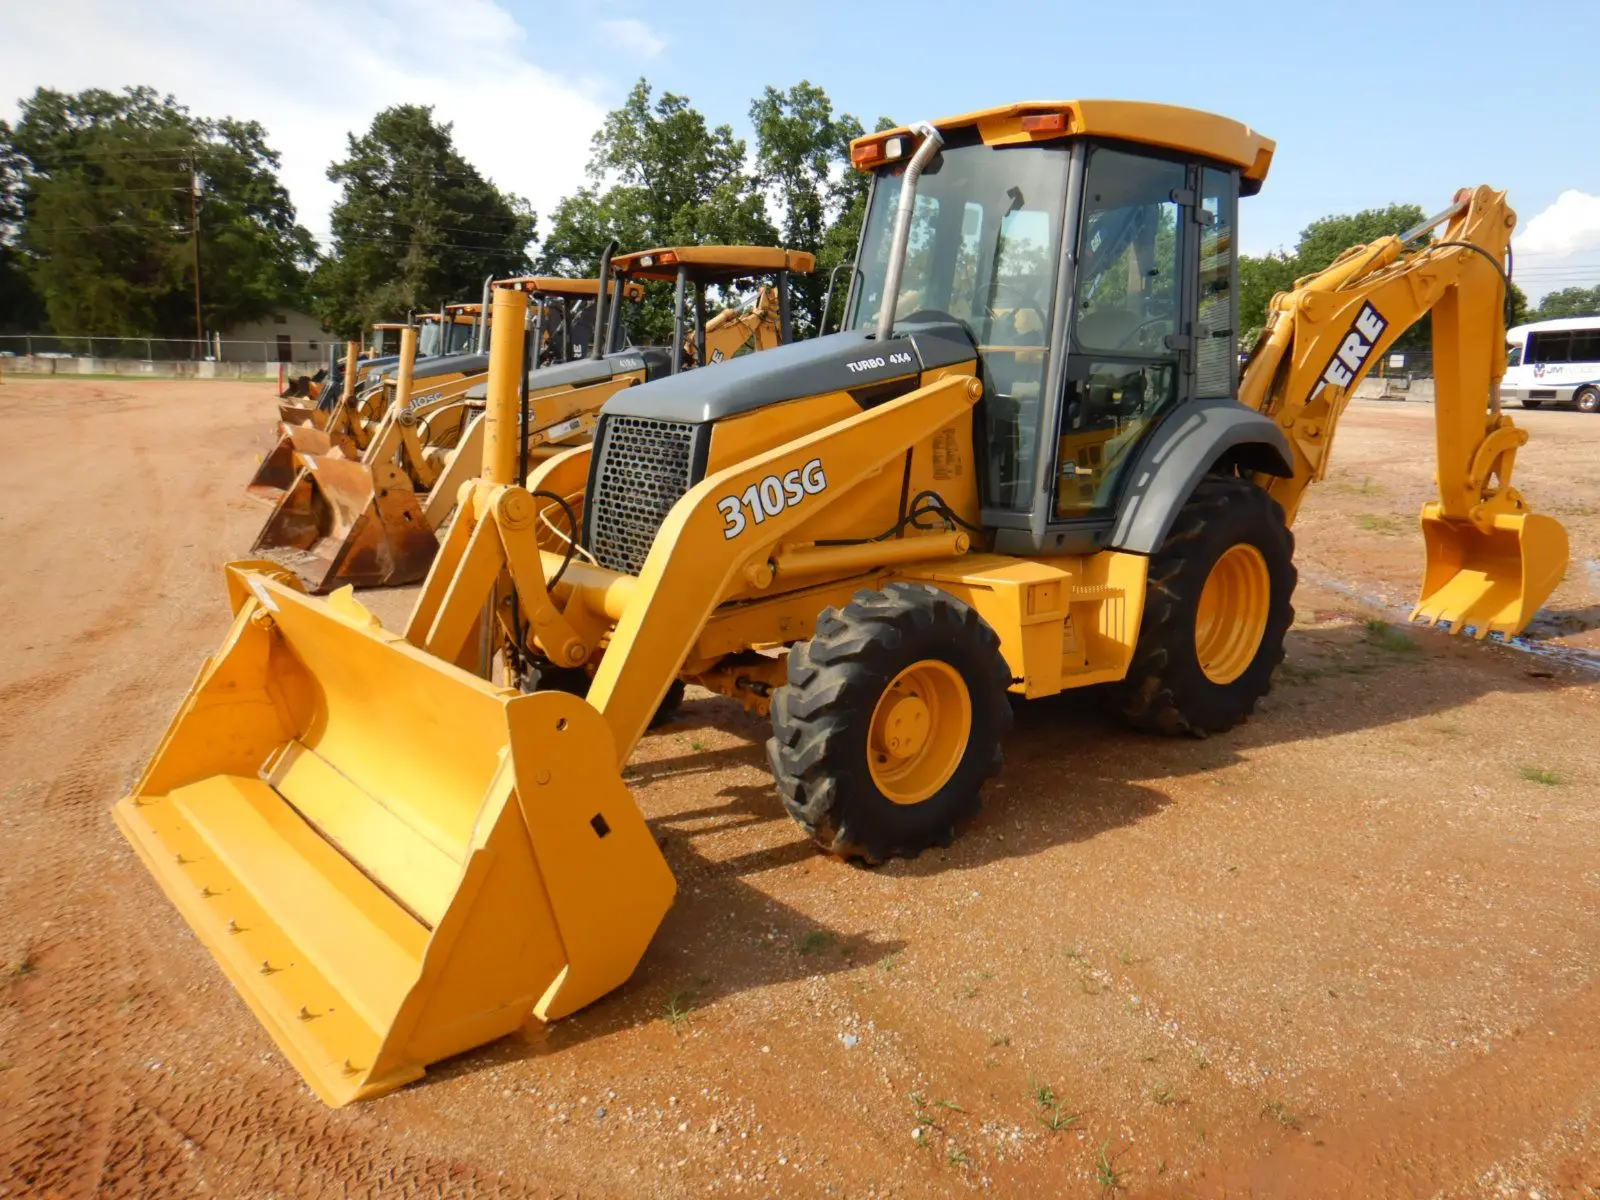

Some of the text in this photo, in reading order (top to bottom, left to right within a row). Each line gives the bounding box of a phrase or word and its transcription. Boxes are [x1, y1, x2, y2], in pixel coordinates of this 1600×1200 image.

[846, 352, 911, 372] TURBO 4X4
[1309, 306, 1385, 401] ERE
[716, 458, 827, 541] 310SG
